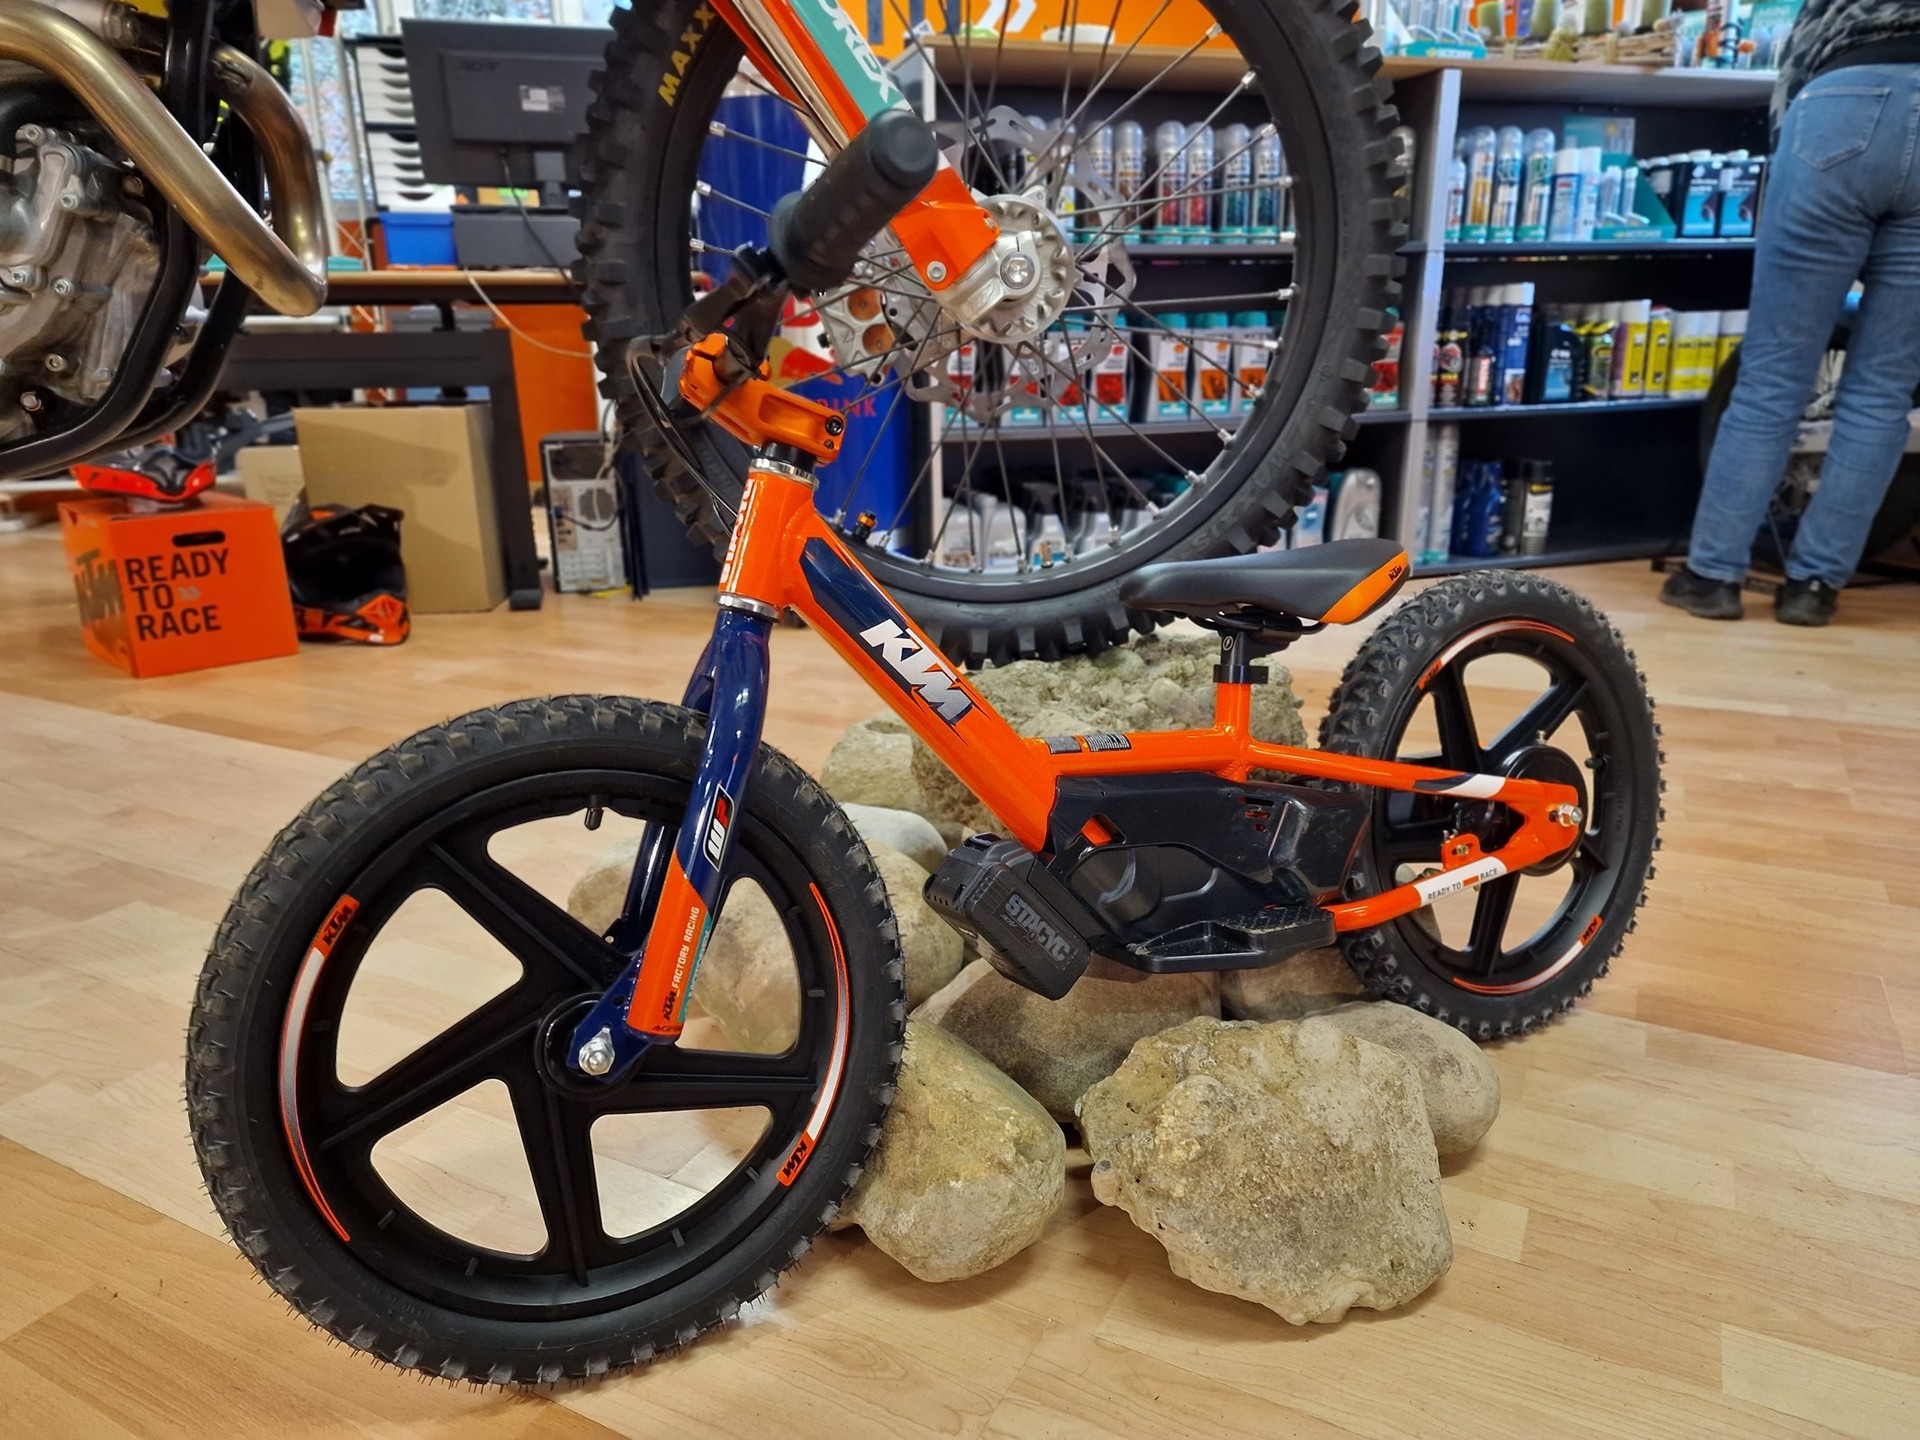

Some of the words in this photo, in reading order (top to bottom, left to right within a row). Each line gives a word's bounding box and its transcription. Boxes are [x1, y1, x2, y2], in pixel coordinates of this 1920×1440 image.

[125, 548, 229, 585] READY
[1388, 565, 1403, 581] KTM
[130, 583, 174, 612] TO
[136, 605, 222, 641] RACE
[859, 618, 973, 721] KTM
[1427, 887, 1450, 901] READY
[1452, 881, 1462, 891] TO
[1480, 867, 1498, 880] RACE
[322, 904, 353, 946] KTM
[687, 906, 700, 943] RACING
[1004, 893, 1071, 961] STACYC
[782, 1140, 808, 1178] KTM
